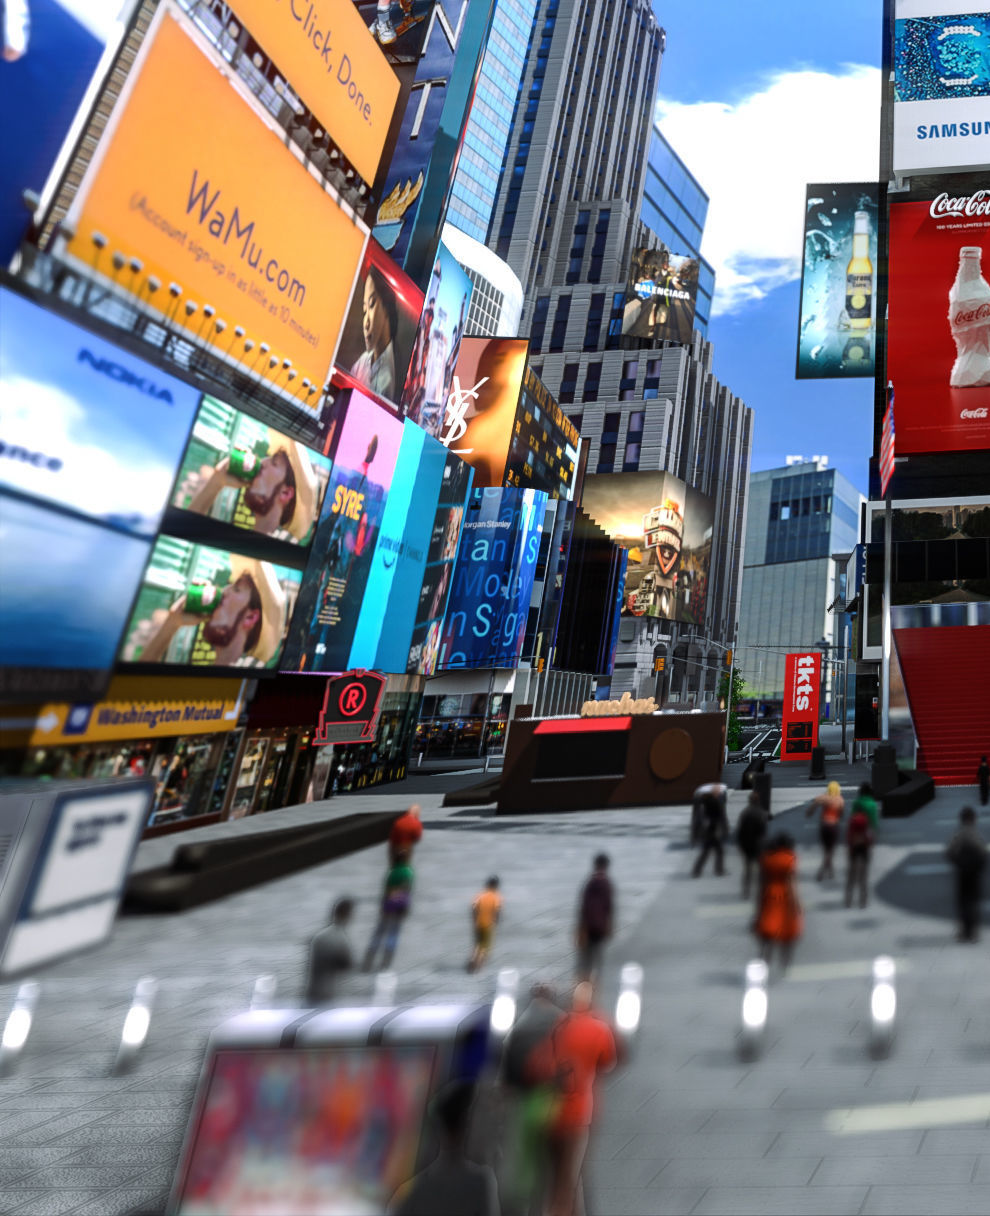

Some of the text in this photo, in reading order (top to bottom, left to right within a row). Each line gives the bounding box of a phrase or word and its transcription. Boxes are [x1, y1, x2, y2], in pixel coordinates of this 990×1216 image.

[336, 53, 372, 126] Done.
[186, 169, 306, 306] WaMu.com
[634, 283, 690, 300] BALENCIAGA
[77, 346, 174, 405] NOKIA
[960, 407, 989, 419] Coca-Cola
[331, 484, 365, 521] SYRE
[463, 520, 512, 530] organ Stanley
[796, 654, 814, 712] tkts
[98, 703, 225, 729] Washington Mutual
